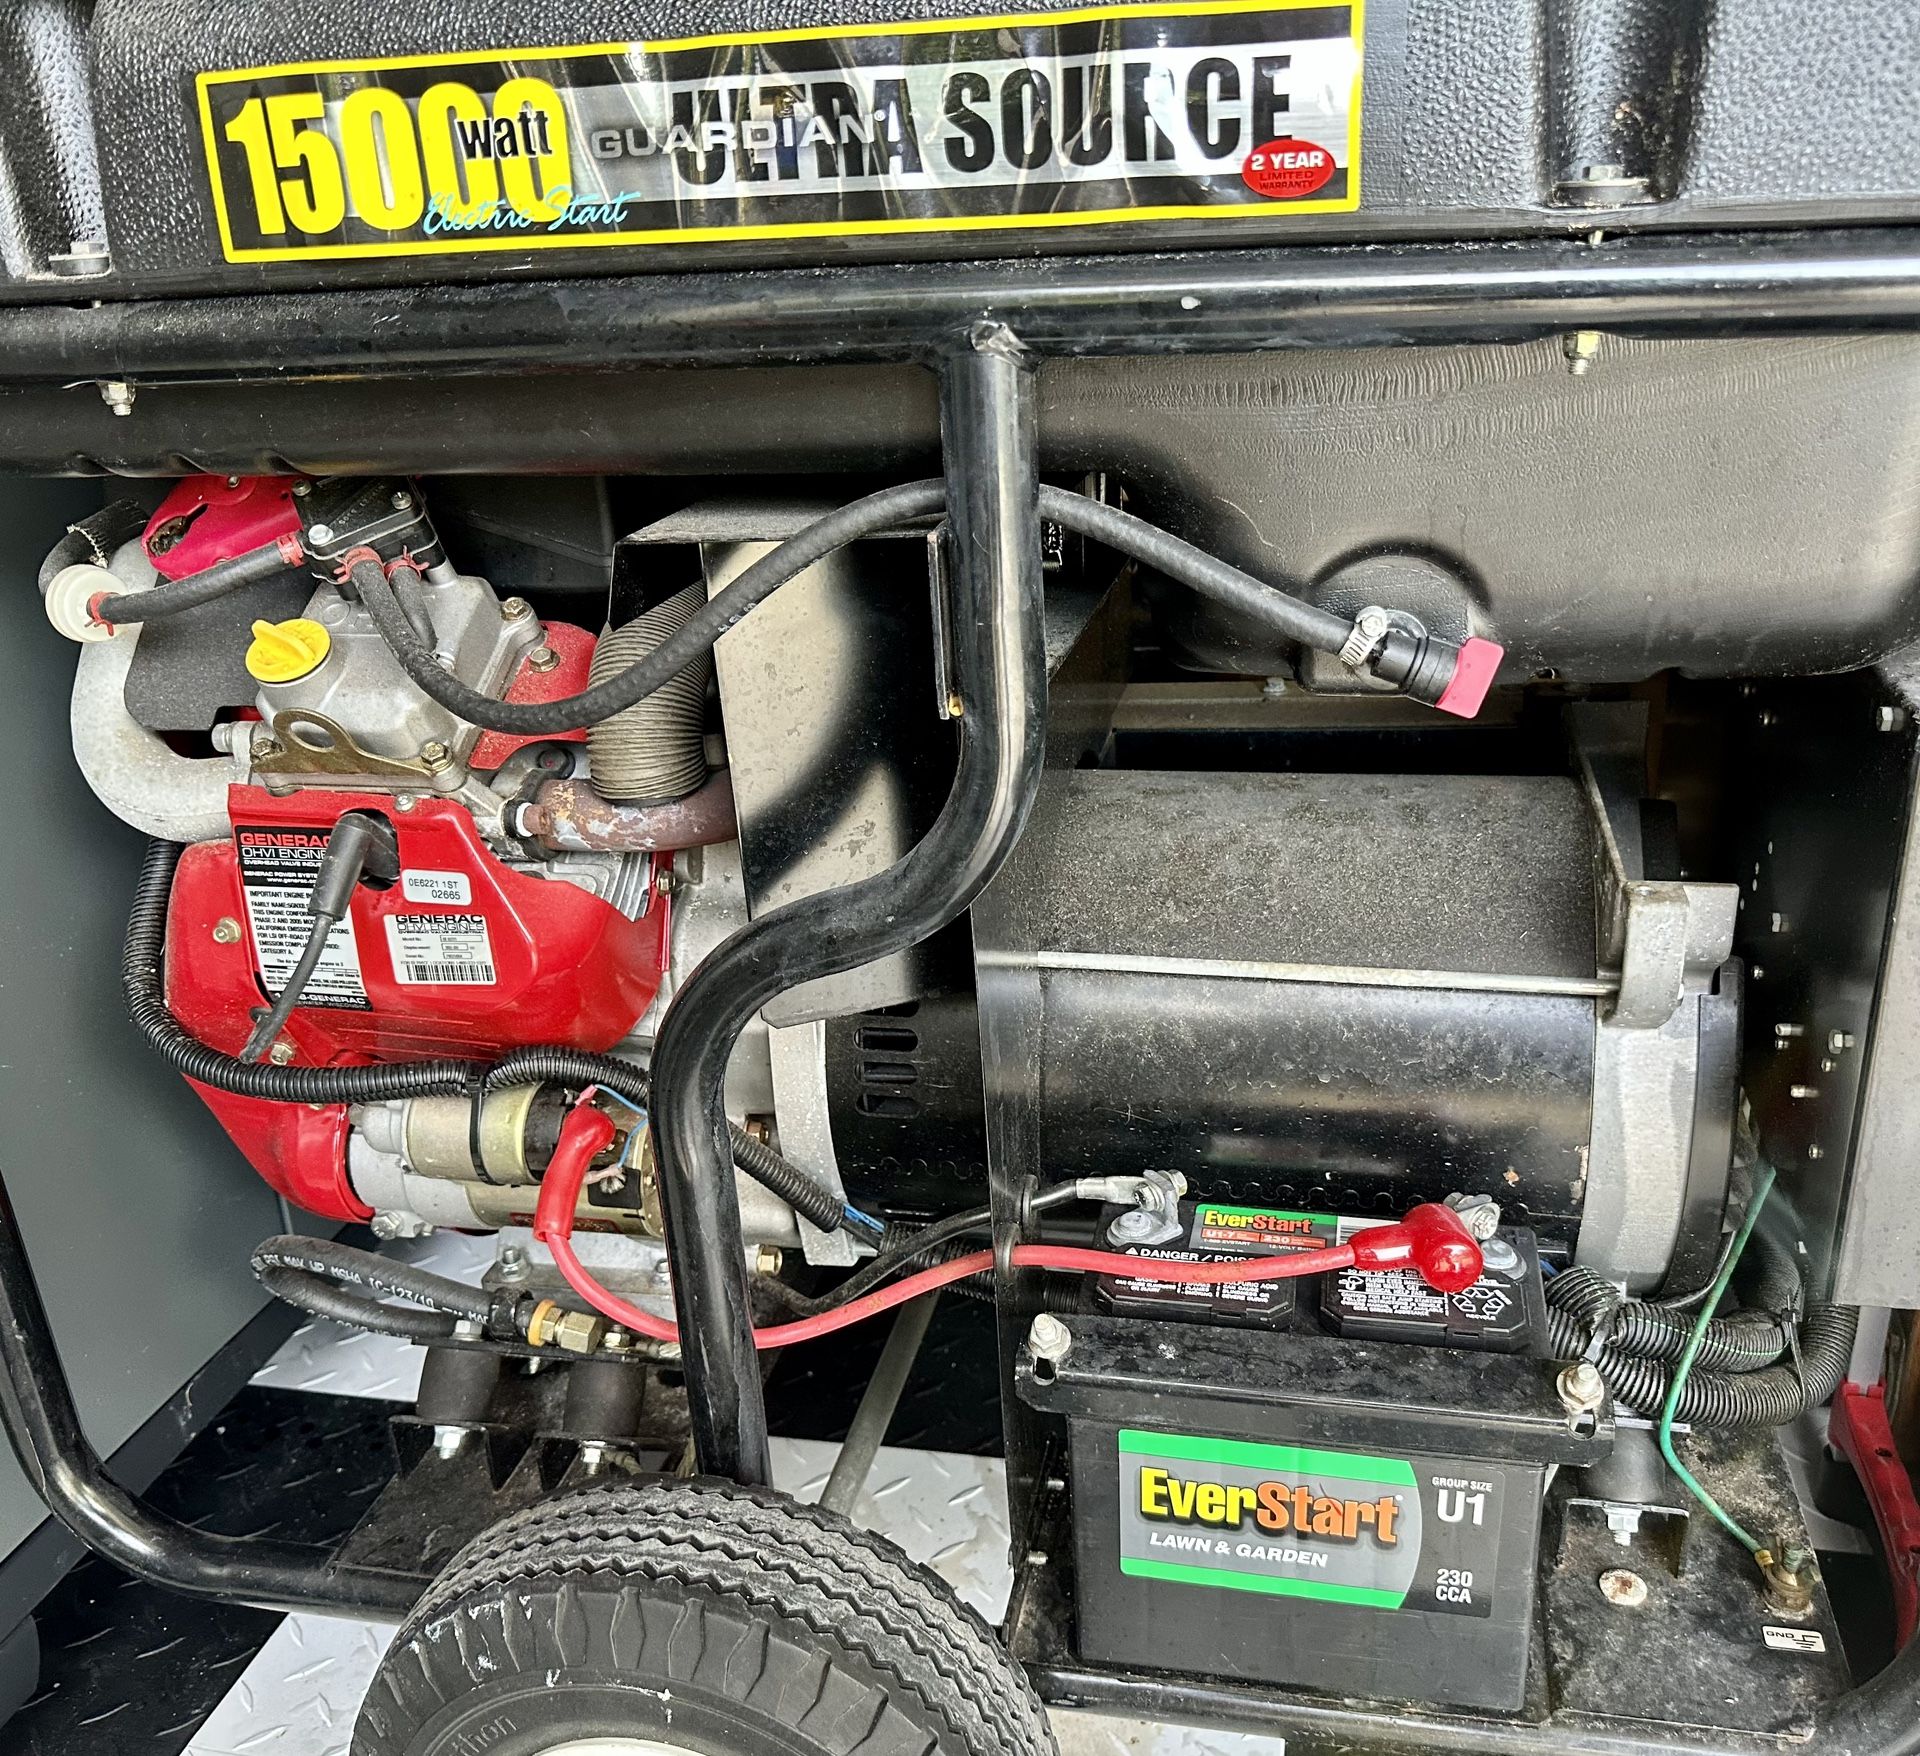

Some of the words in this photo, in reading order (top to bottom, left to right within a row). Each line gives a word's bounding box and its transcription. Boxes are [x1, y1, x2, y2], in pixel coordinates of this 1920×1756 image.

[671, 79, 925, 186] ULTRA
[944, 55, 1292, 174] SOURCE
[454, 110, 552, 160] watt
[225, 77, 572, 236] 15000
[1251, 153, 1265, 171] 2
[1270, 150, 1325, 170] YEAR
[1260, 170, 1314, 181] LIMITED
[1260, 180, 1314, 190] WARRANTY
[422, 191, 532, 235] Electric
[545, 185, 643, 231] Start
[442, 881, 459, 889] 1ST
[250, 890, 282, 898] IMPORTANT
[432, 889, 460, 900] 02665
[396, 914, 483, 924] GENERAC
[430, 922, 485, 931] ENGINES
[1203, 1210, 1312, 1234] EverStart
[1206, 1229, 1235, 1239] U1-7
[1263, 1235, 1291, 1244] 230
[1140, 1248, 1199, 1261] DANGER
[330, 1266, 363, 1284] MSHA
[1466, 1313, 1497, 1321] RECYCLE
[1431, 1476, 1468, 1490] GROUP
[1470, 1480, 1493, 1493] SIZE
[1139, 1465, 1400, 1545] EverStart
[1437, 1489, 1485, 1526] U1
[1149, 1532, 1211, 1554] LAWN
[1215, 1537, 1231, 1555] &
[1235, 1541, 1328, 1568] GARDEN
[1437, 1567, 1473, 1587] 230
[1434, 1585, 1472, 1604] CCA
[1765, 1630, 1795, 1639] GND
